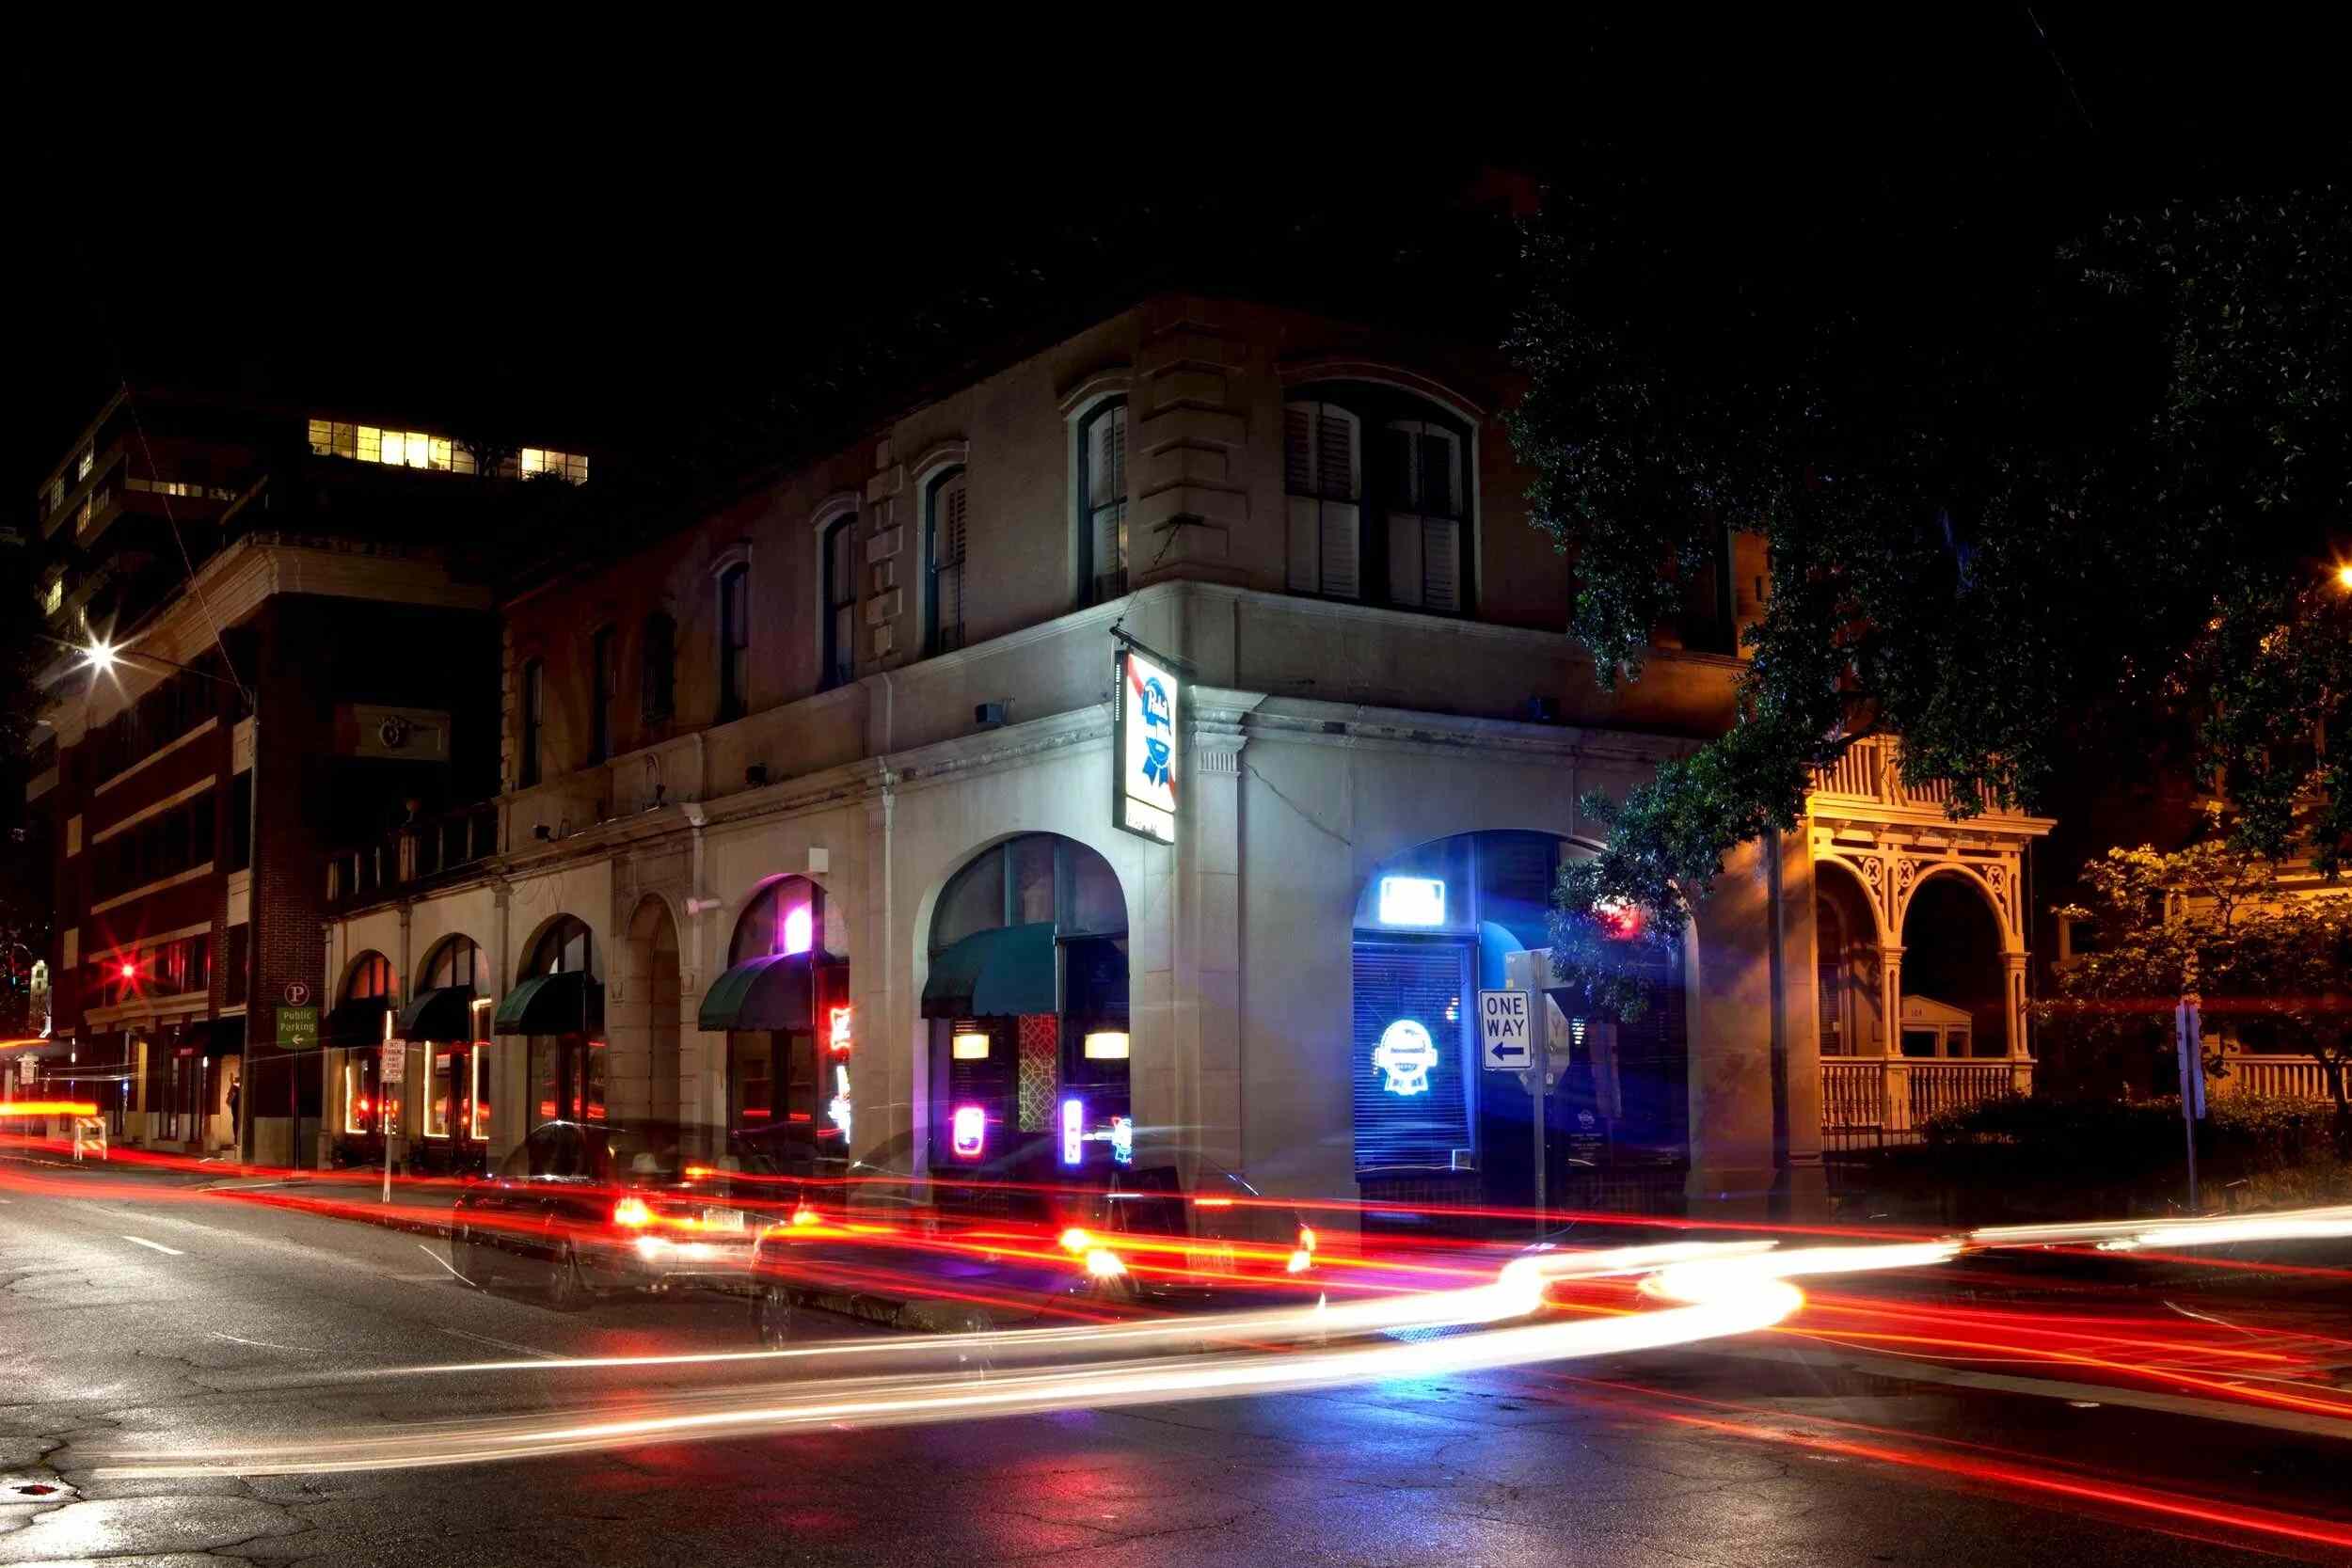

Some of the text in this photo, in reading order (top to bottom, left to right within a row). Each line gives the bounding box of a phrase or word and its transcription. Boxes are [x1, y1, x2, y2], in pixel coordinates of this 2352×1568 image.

[291, 986, 305, 1002] P
[1486, 997, 1523, 1015] ONE
[284, 1010, 311, 1020] Public
[279, 1022, 314, 1033] Parking
[1486, 1019, 1525, 1037] WAY
